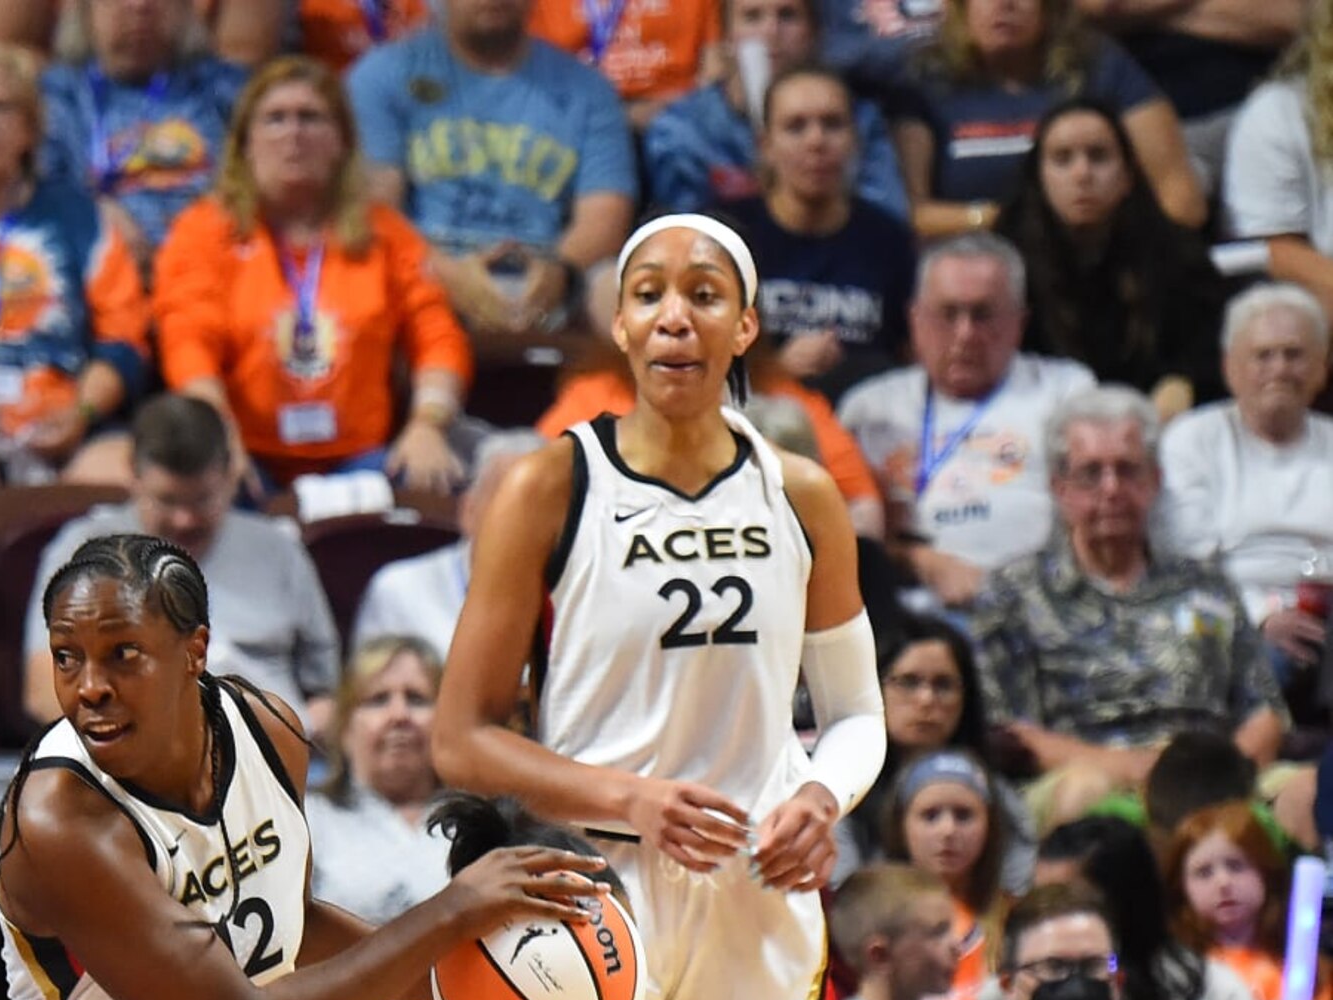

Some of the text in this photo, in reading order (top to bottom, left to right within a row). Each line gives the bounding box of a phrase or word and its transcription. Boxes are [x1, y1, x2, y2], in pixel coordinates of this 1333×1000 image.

[758, 279, 883, 330] CONN
[621, 525, 773, 570] ACES
[657, 575, 759, 650] 22
[179, 817, 282, 907] ACES
